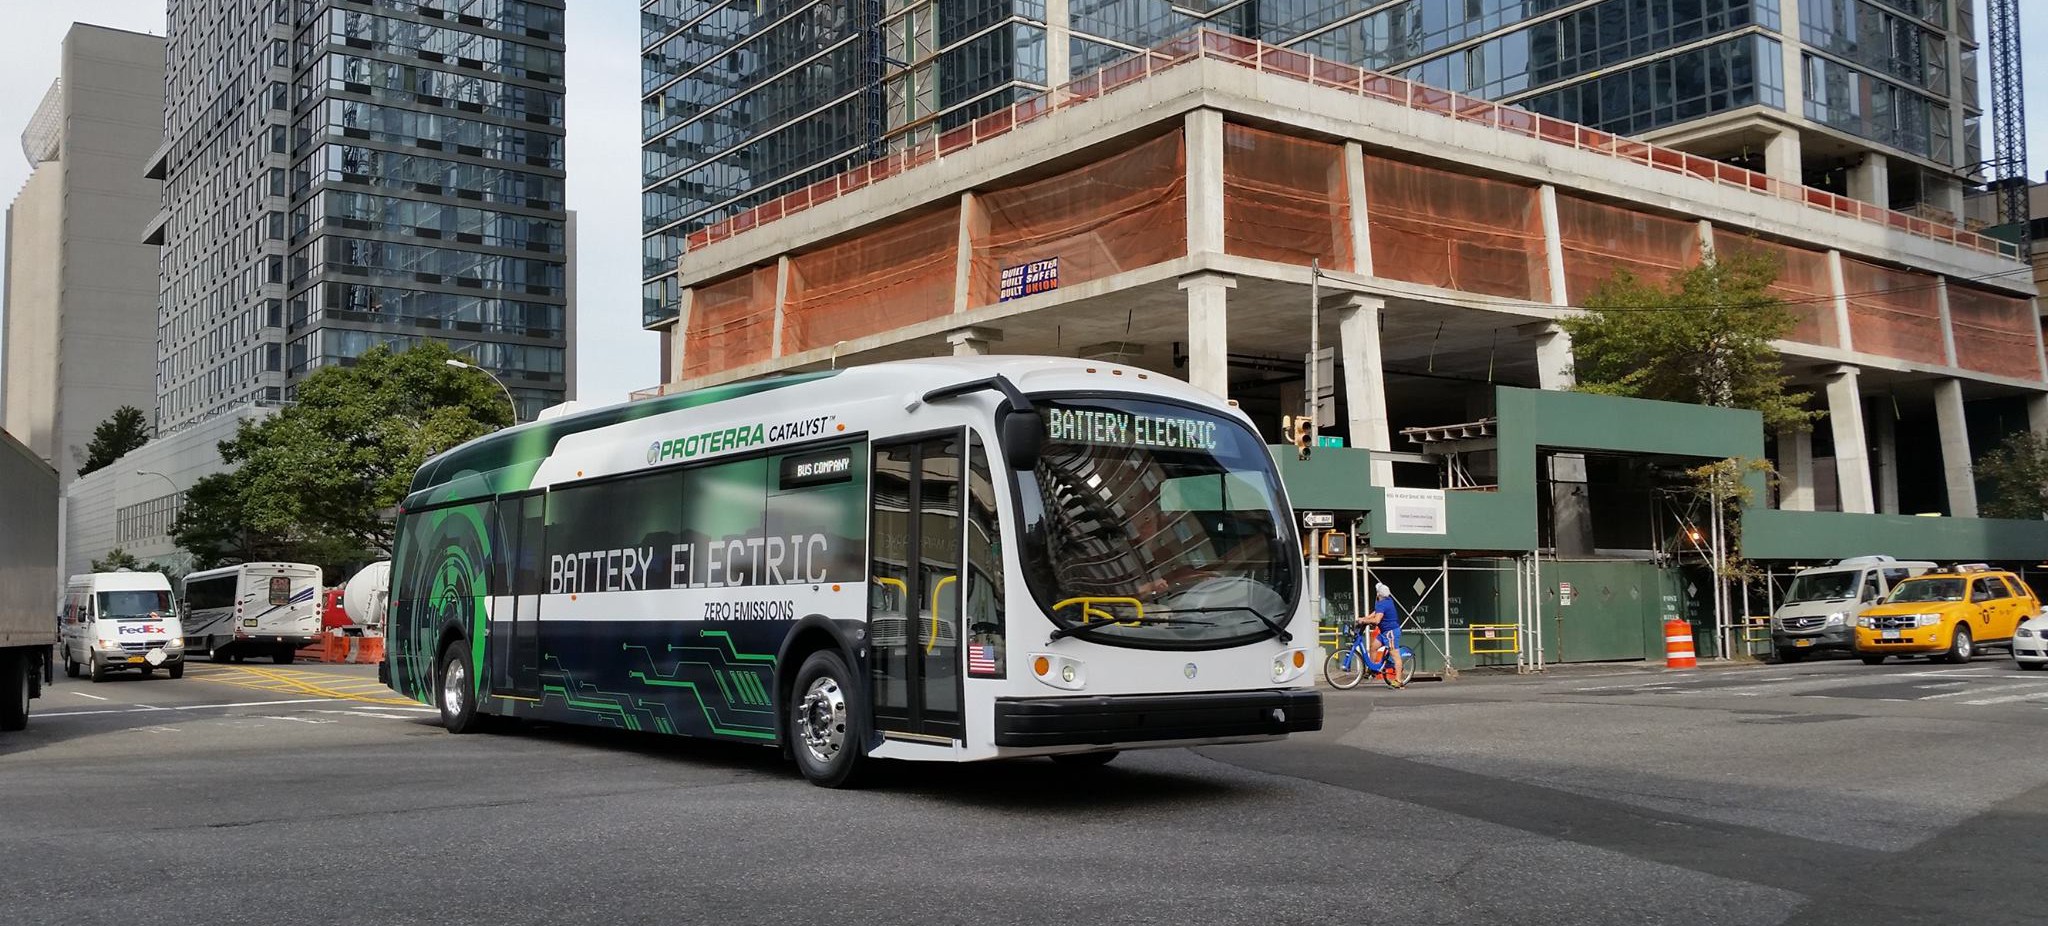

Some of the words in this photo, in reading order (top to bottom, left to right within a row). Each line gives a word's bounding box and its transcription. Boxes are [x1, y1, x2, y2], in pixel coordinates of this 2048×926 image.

[1001, 276, 1024, 289] BUILT
[1025, 268, 1057, 284] SAFER
[1002, 266, 1026, 279] BUILT
[1000, 286, 1024, 299] BUILT
[1025, 278, 1057, 294] UNION
[659, 423, 765, 462] PROTERRA
[768, 416, 829, 442] CATALYST
[1049, 408, 1129, 444] BATTERY
[1134, 416, 1217, 449] ELECTRIC
[797, 462, 813, 478] BUS
[813, 458, 850, 475] COMPANY
[550, 546, 654, 594] BATTERY
[670, 533, 828, 589] ELECTRIC
[1333, 591, 1353, 600] POST
[704, 602, 731, 621] ZERO
[734, 600, 794, 621] EMISSIONS
[118, 624, 166, 635] FedEx
